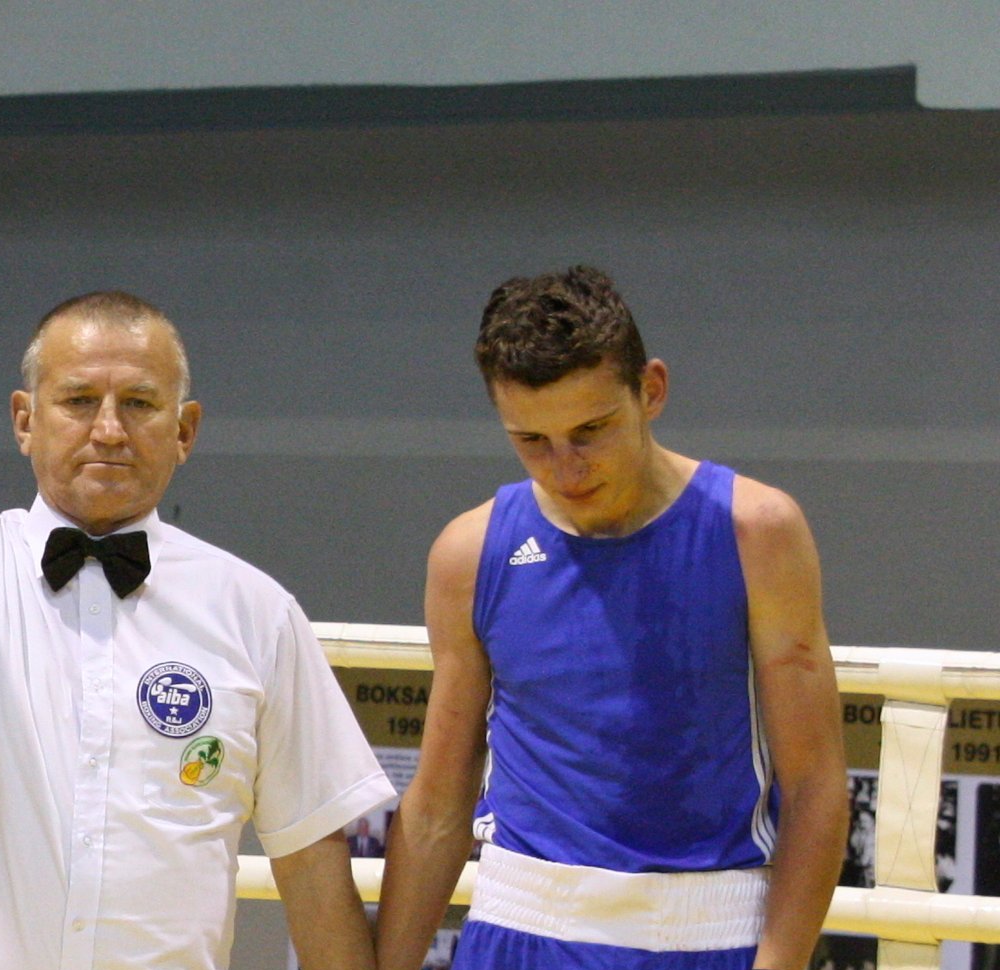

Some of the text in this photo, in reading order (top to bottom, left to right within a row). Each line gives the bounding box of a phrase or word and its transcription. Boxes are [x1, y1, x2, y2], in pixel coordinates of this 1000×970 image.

[509, 553, 547, 565] adidas
[143, 664, 206, 692] INTERNATIONAL
[157, 688, 190, 706] aiba
[387, 716, 425, 735] 199
[843, 704, 1000, 729] BO LIET
